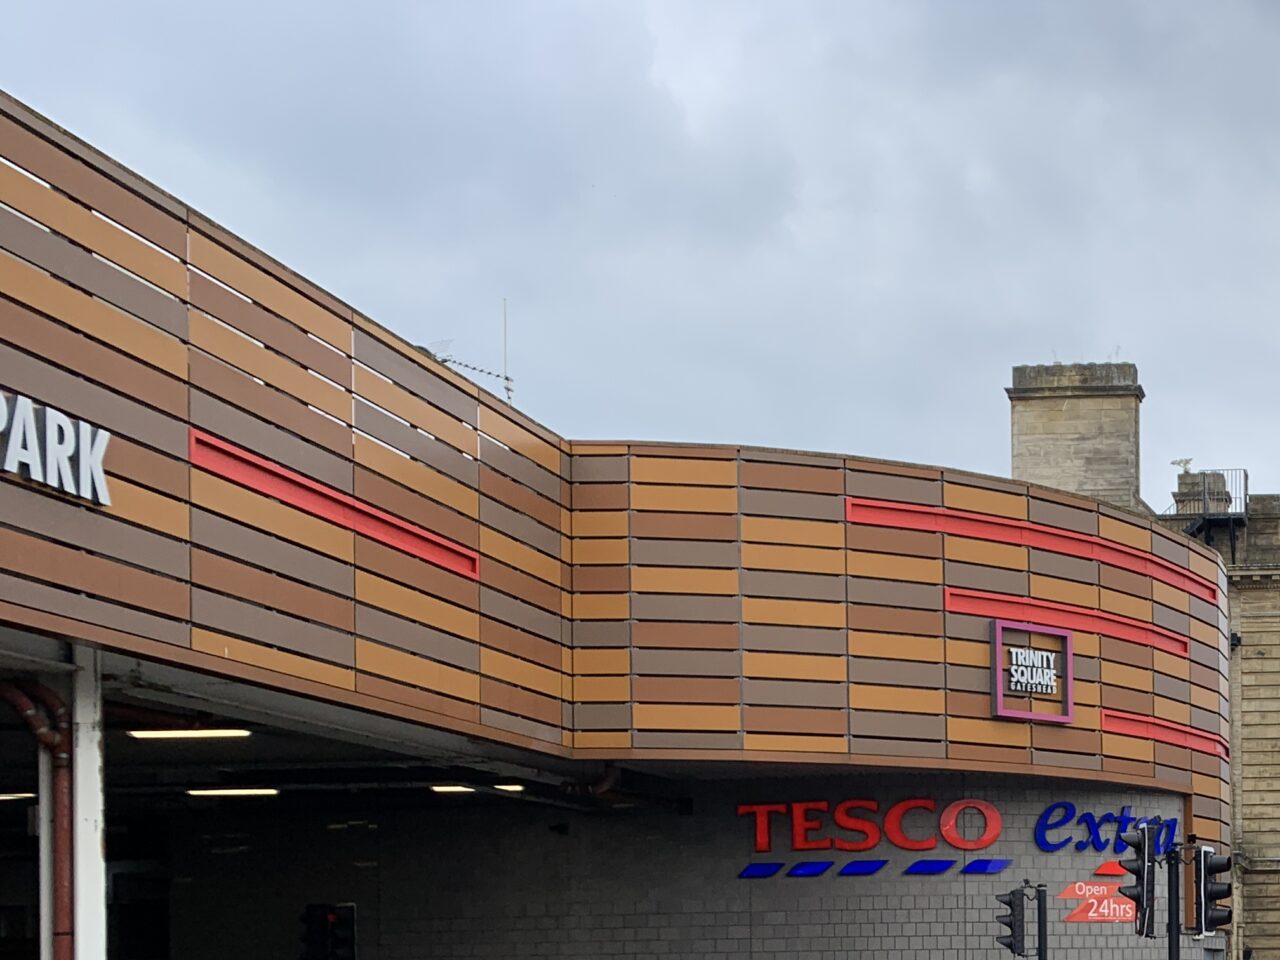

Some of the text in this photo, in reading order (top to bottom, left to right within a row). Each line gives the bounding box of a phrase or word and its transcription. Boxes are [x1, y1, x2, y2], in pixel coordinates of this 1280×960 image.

[0, 390, 112, 507] ARK
[1009, 648, 1056, 669] TRINITY
[1010, 665, 1057, 686] SQUARE
[1010, 682, 1057, 694] GATESHEAD
[737, 798, 1003, 853] TESCO
[1075, 882, 1107, 898] Open
[1087, 898, 1133, 917] 24hrs
